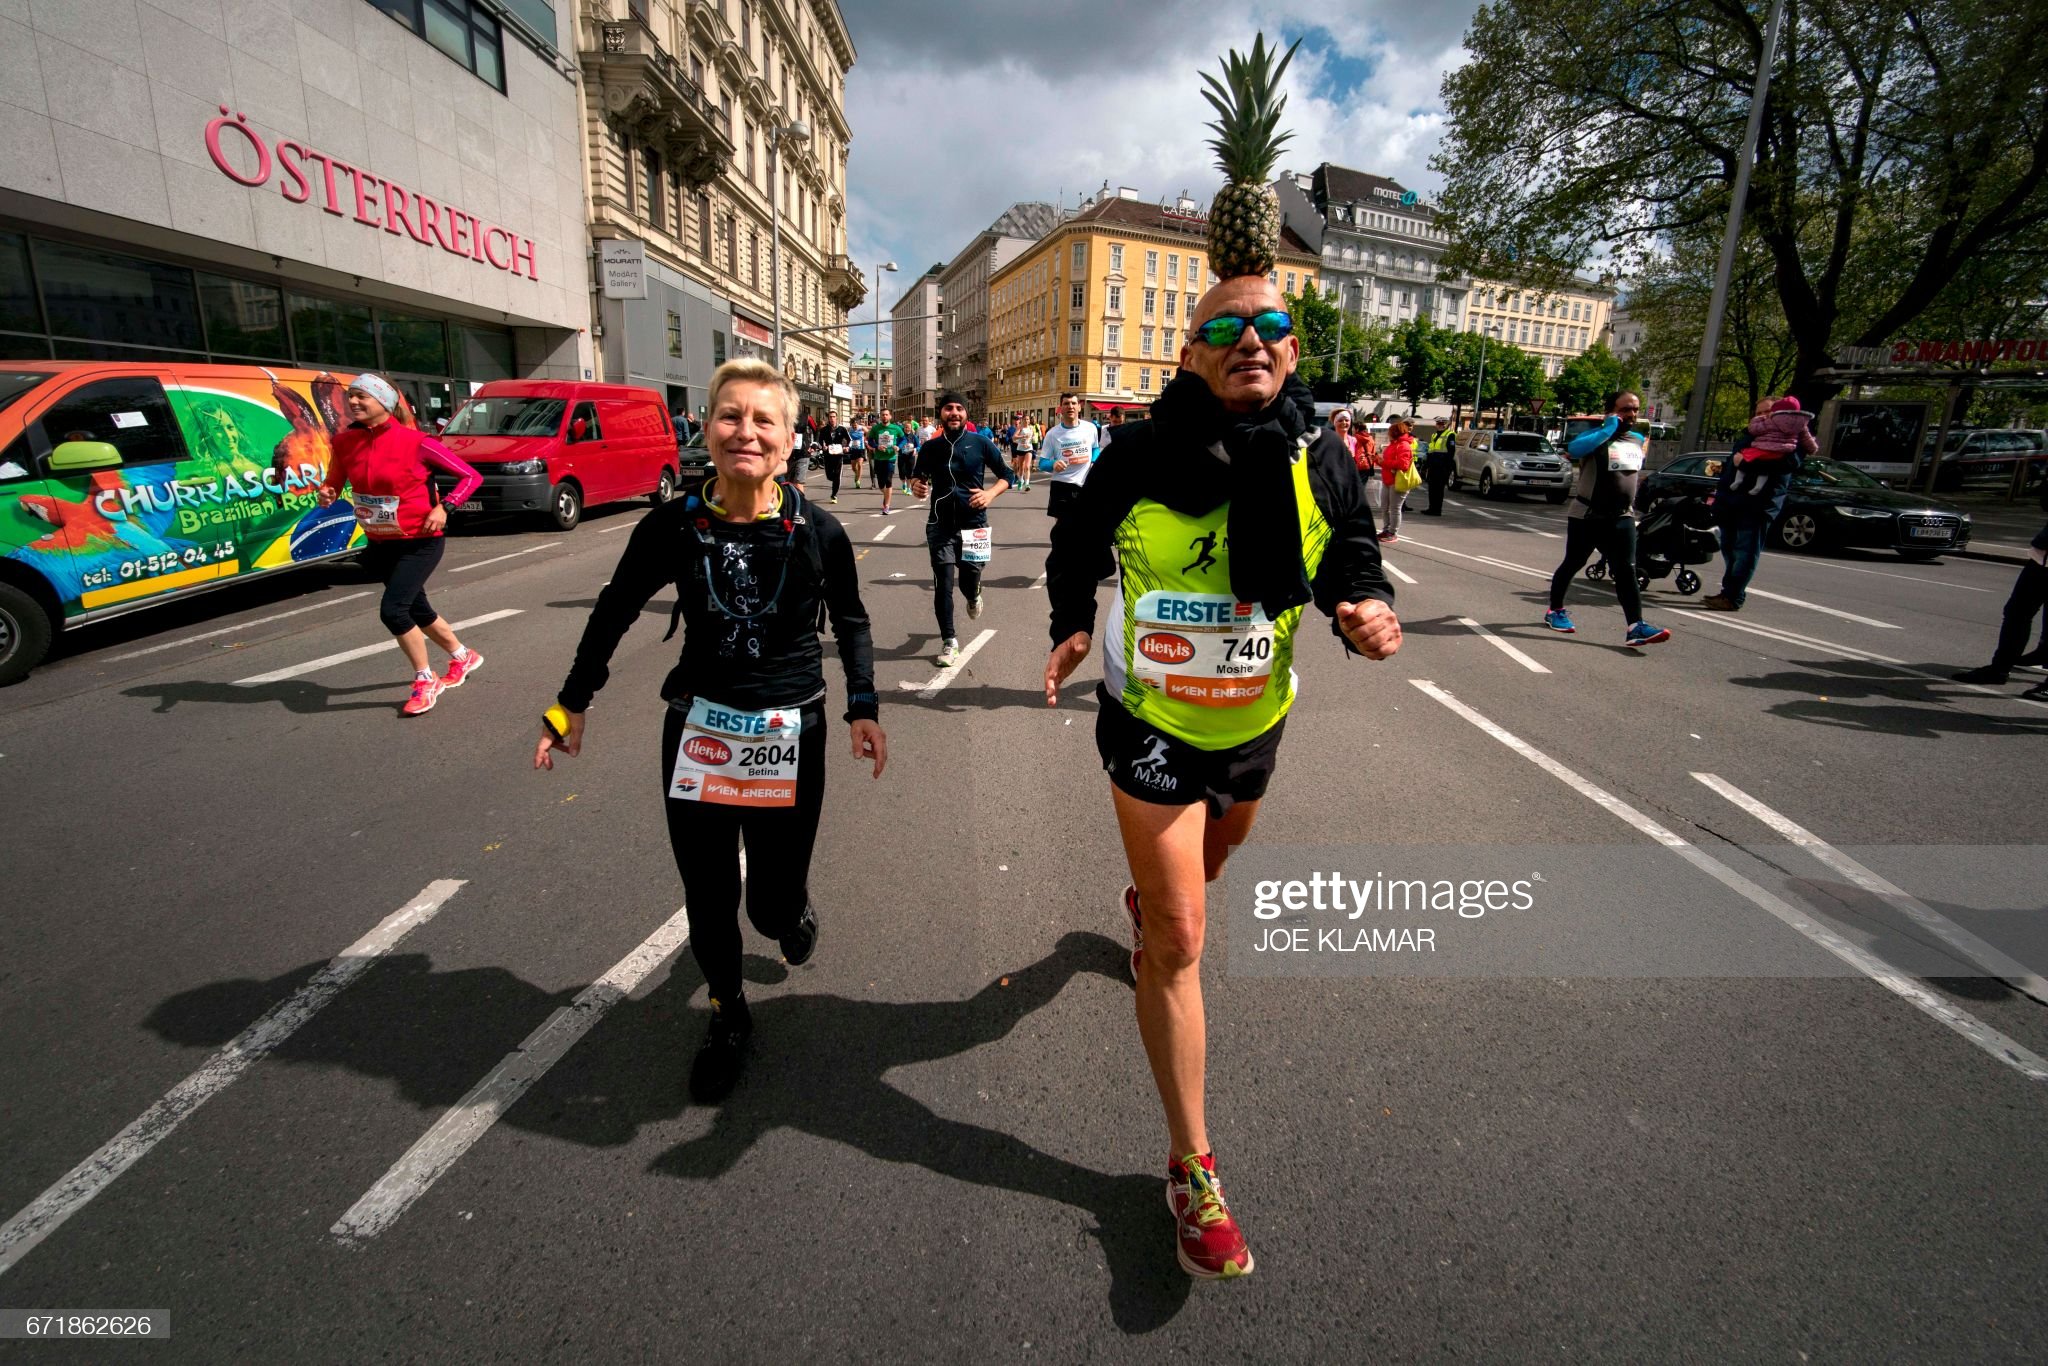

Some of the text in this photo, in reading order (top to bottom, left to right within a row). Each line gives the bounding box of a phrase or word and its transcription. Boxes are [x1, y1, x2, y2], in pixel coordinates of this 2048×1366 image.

[204, 103, 539, 282] ÖSTERREICH
[608, 270, 638, 278] ModArt
[610, 280, 637, 289] Gallery
[94, 463, 328, 522] CHURRASCARI
[178, 497, 274, 535] Brazilian
[83, 541, 235, 588] tel: 01-512 04 45
[1157, 598, 1232, 623] ERSTE
[1144, 638, 1190, 658] Hervis
[1222, 637, 1271, 662] 740
[1216, 664, 1254, 674] Moshe
[1211, 685, 1265, 698] ENERGIE
[705, 709, 767, 735] ERSTE
[688, 740, 729, 760] Hervis
[738, 745, 797, 767] 2604
[748, 768, 779, 776] Betina
[742, 788, 792, 798] ENERGIE
